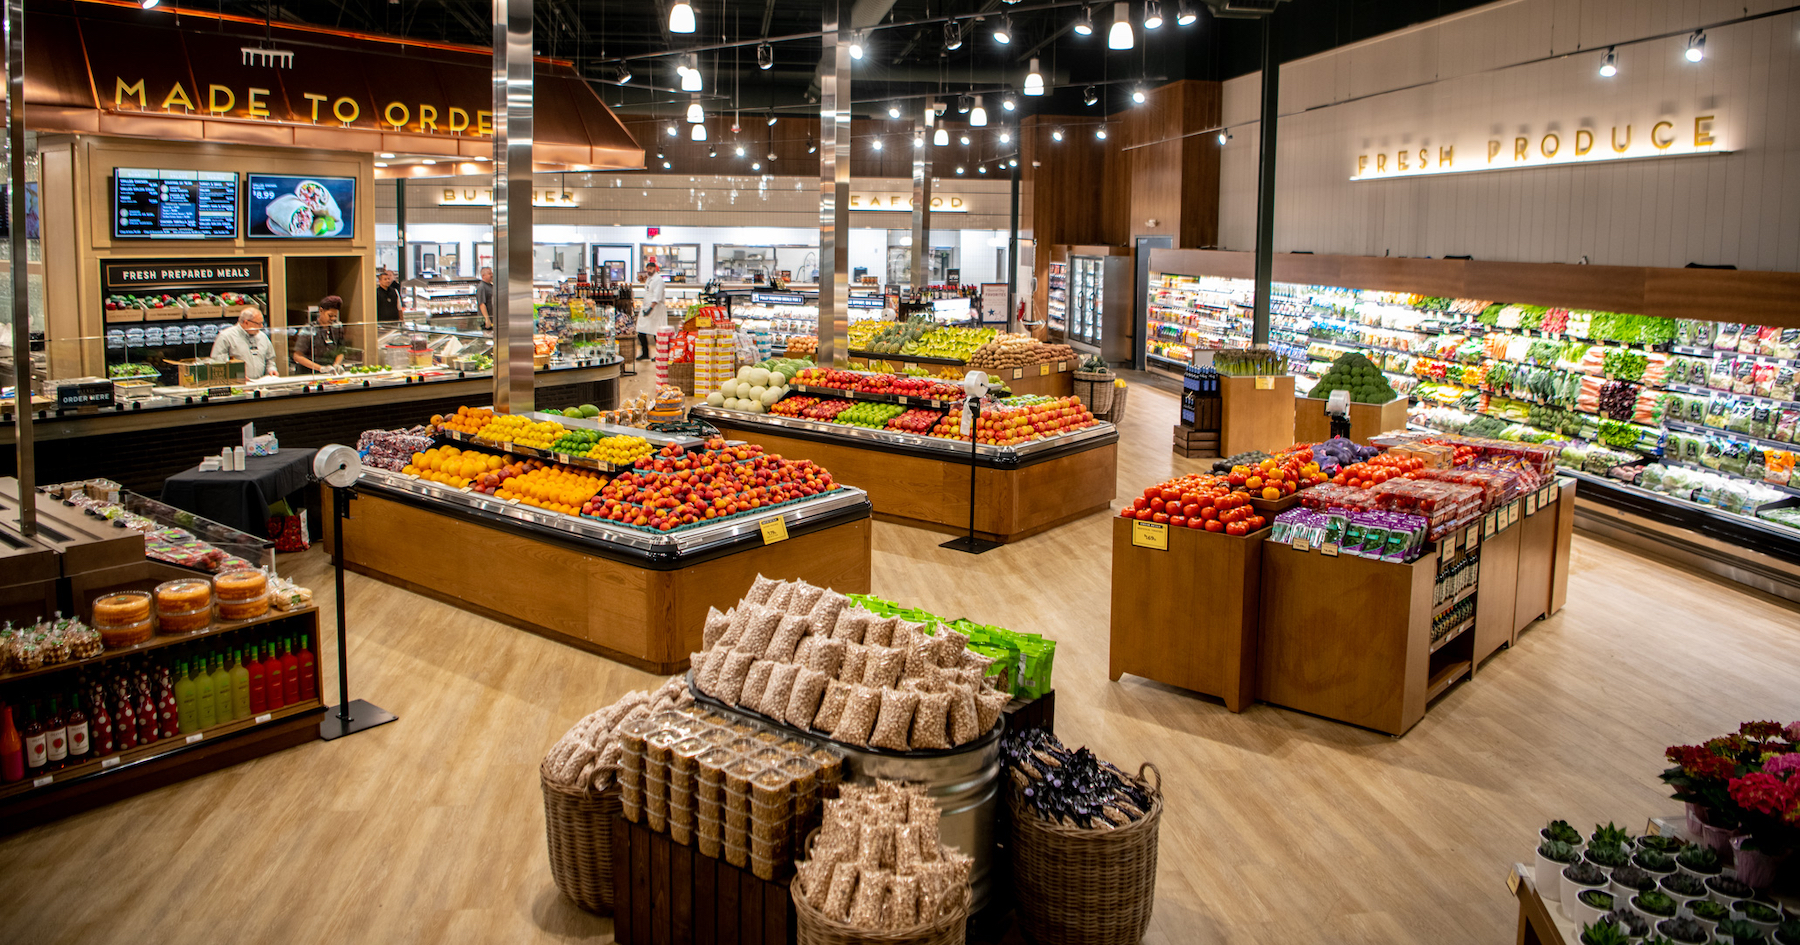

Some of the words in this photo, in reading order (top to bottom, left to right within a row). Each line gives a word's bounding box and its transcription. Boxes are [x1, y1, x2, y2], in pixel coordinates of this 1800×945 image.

[115, 76, 271, 117] MADE
[304, 93, 360, 124] TO
[384, 101, 493, 136] ORDE
[1358, 145, 1453, 175] FRESH
[1488, 116, 1715, 163] PRODUCE
[252, 191, 275, 200] $8.99
[443, 189, 574, 203] BUTER
[851, 196, 962, 207] EAFOD
[123, 271, 156, 280] FRESH
[161, 269, 214, 279] PREPARED
[216, 268, 250, 278] MEALS
[63, 395, 88, 403] ORDER
